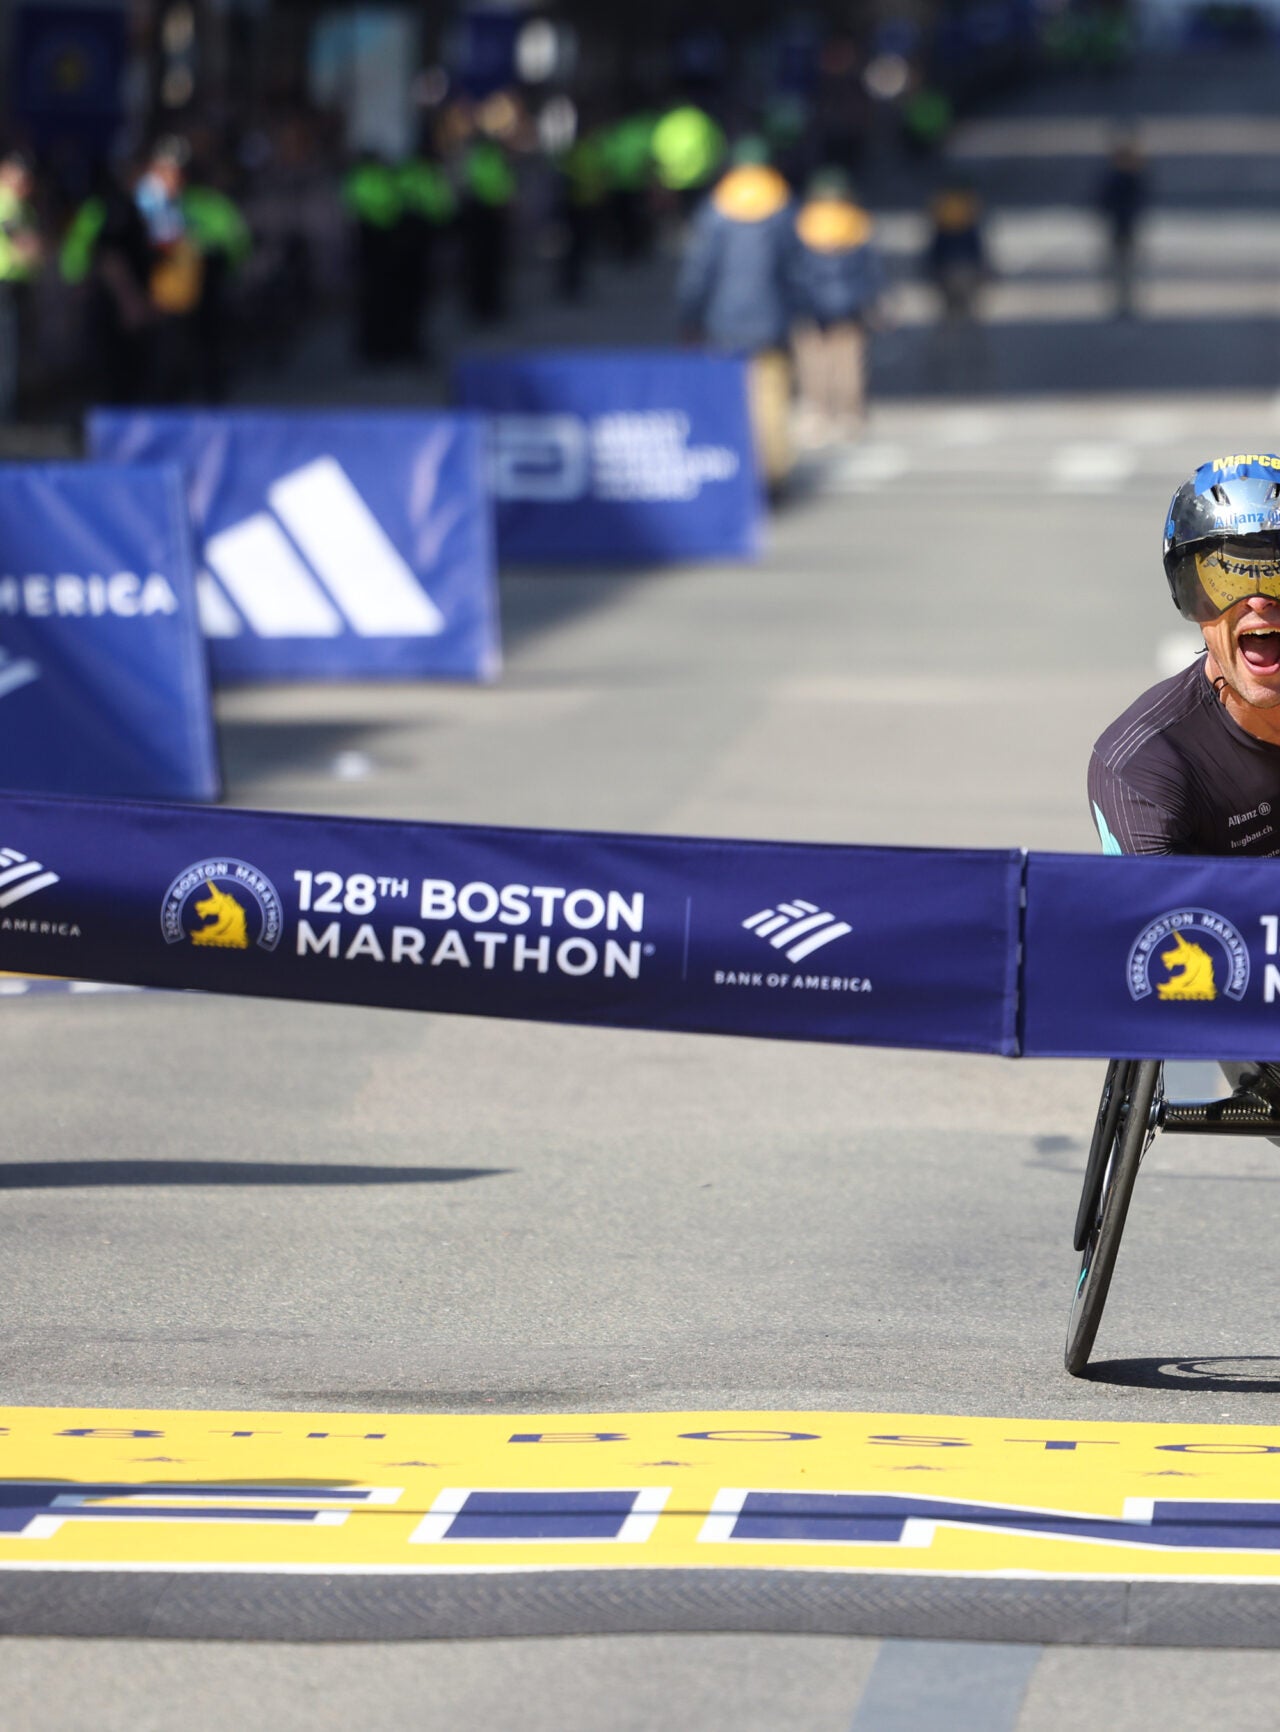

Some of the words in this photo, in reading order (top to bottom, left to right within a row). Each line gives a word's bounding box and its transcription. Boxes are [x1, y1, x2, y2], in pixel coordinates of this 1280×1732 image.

[1214, 512, 1264, 528] Allianz
[1228, 809, 1257, 828] Allianz
[1230, 825, 1273, 849] hugbau.ch
[172, 864, 228, 900] BOSTON
[235, 865, 278, 942] MARATHON
[293, 869, 409, 916] 128TH
[420, 878, 644, 933] BOSTON
[1, 918, 80, 936] AMERICA
[1139, 913, 1193, 952] BOSTON
[1201, 914, 1246, 991] MARATHON
[714, 970, 762, 987] BANK
[767, 973, 790, 988] OF
[792, 975, 872, 992] AMERICA
